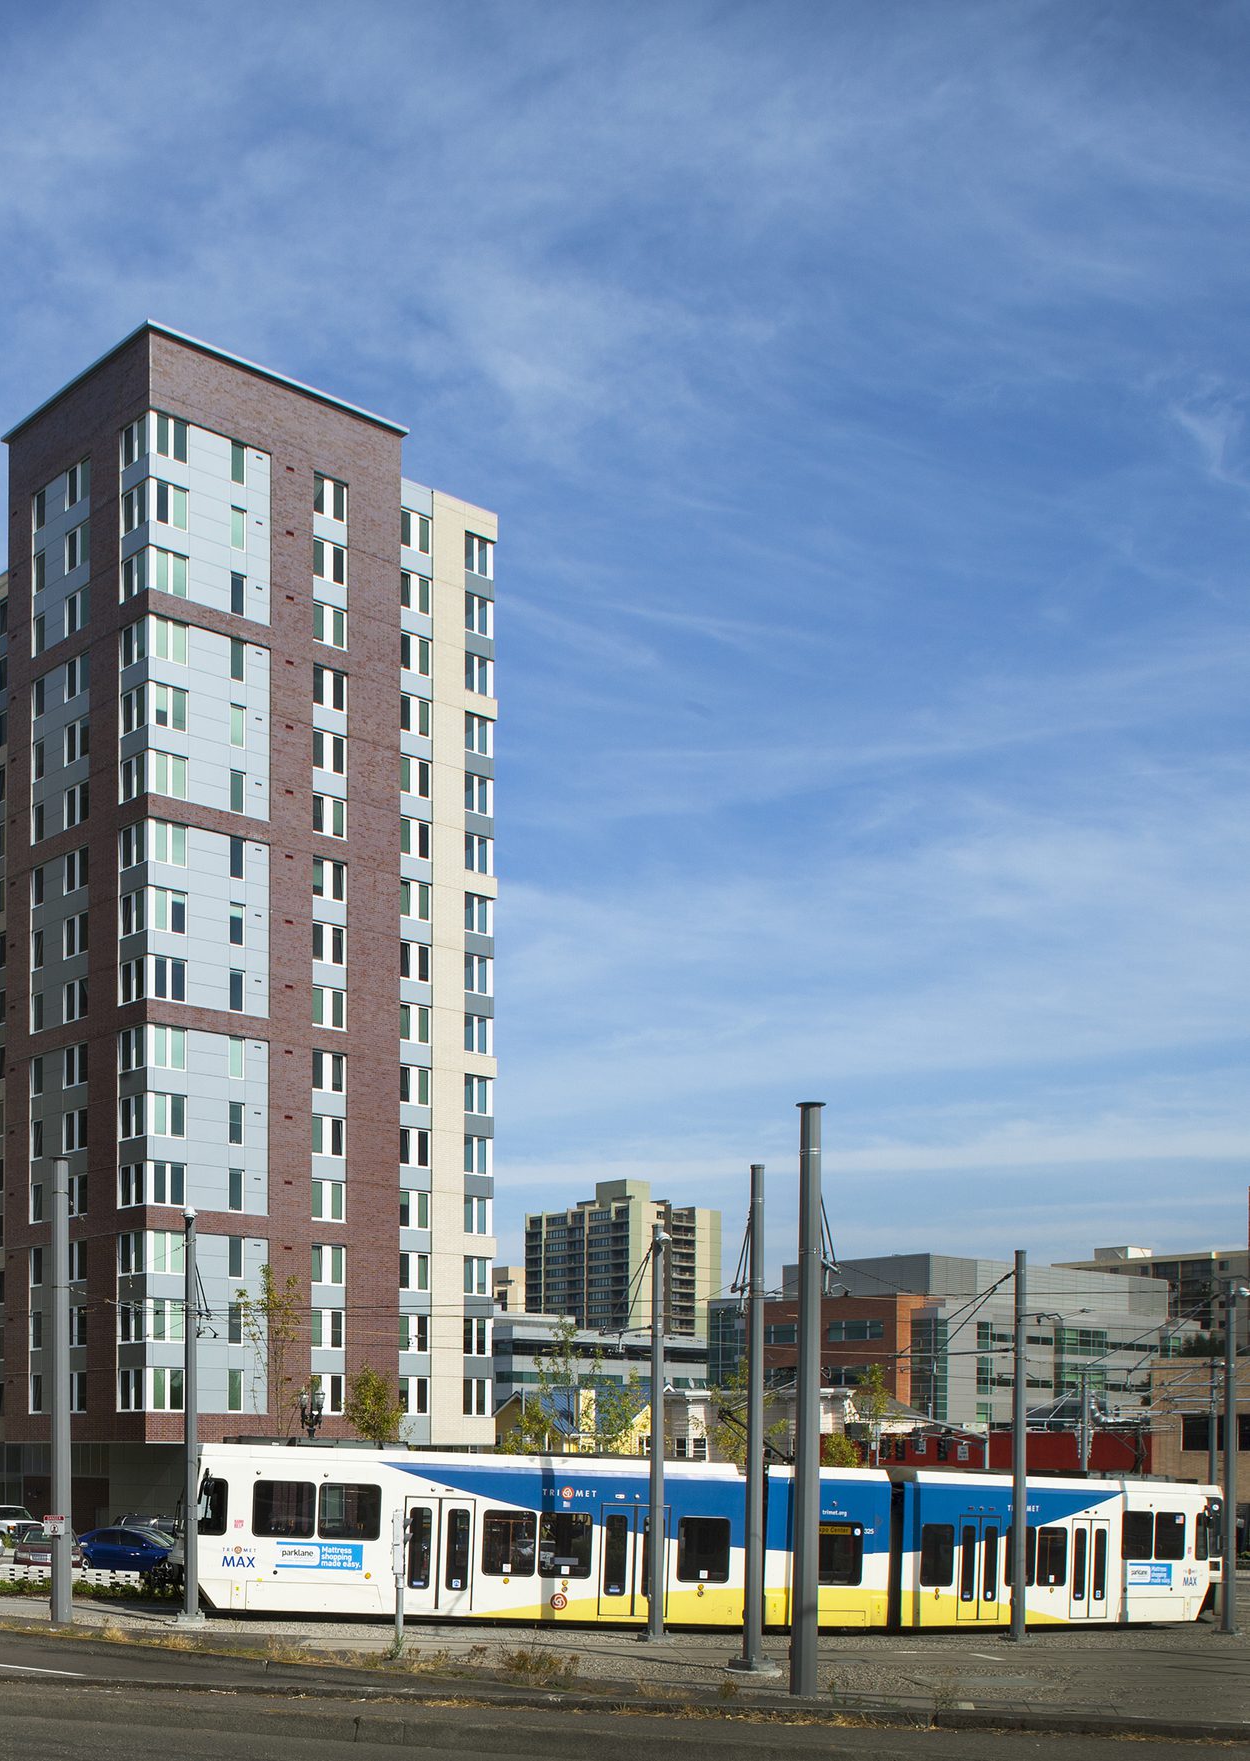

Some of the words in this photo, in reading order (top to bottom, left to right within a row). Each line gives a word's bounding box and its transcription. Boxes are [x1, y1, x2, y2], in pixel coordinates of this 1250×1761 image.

[822, 1509, 848, 1517] trimet.org
[281, 1549, 314, 1558] parklane
[321, 1546, 352, 1554] Mattress
[221, 1556, 256, 1568] MAX
[321, 1553, 352, 1562] shopping
[1183, 1576, 1198, 1587] MAX
